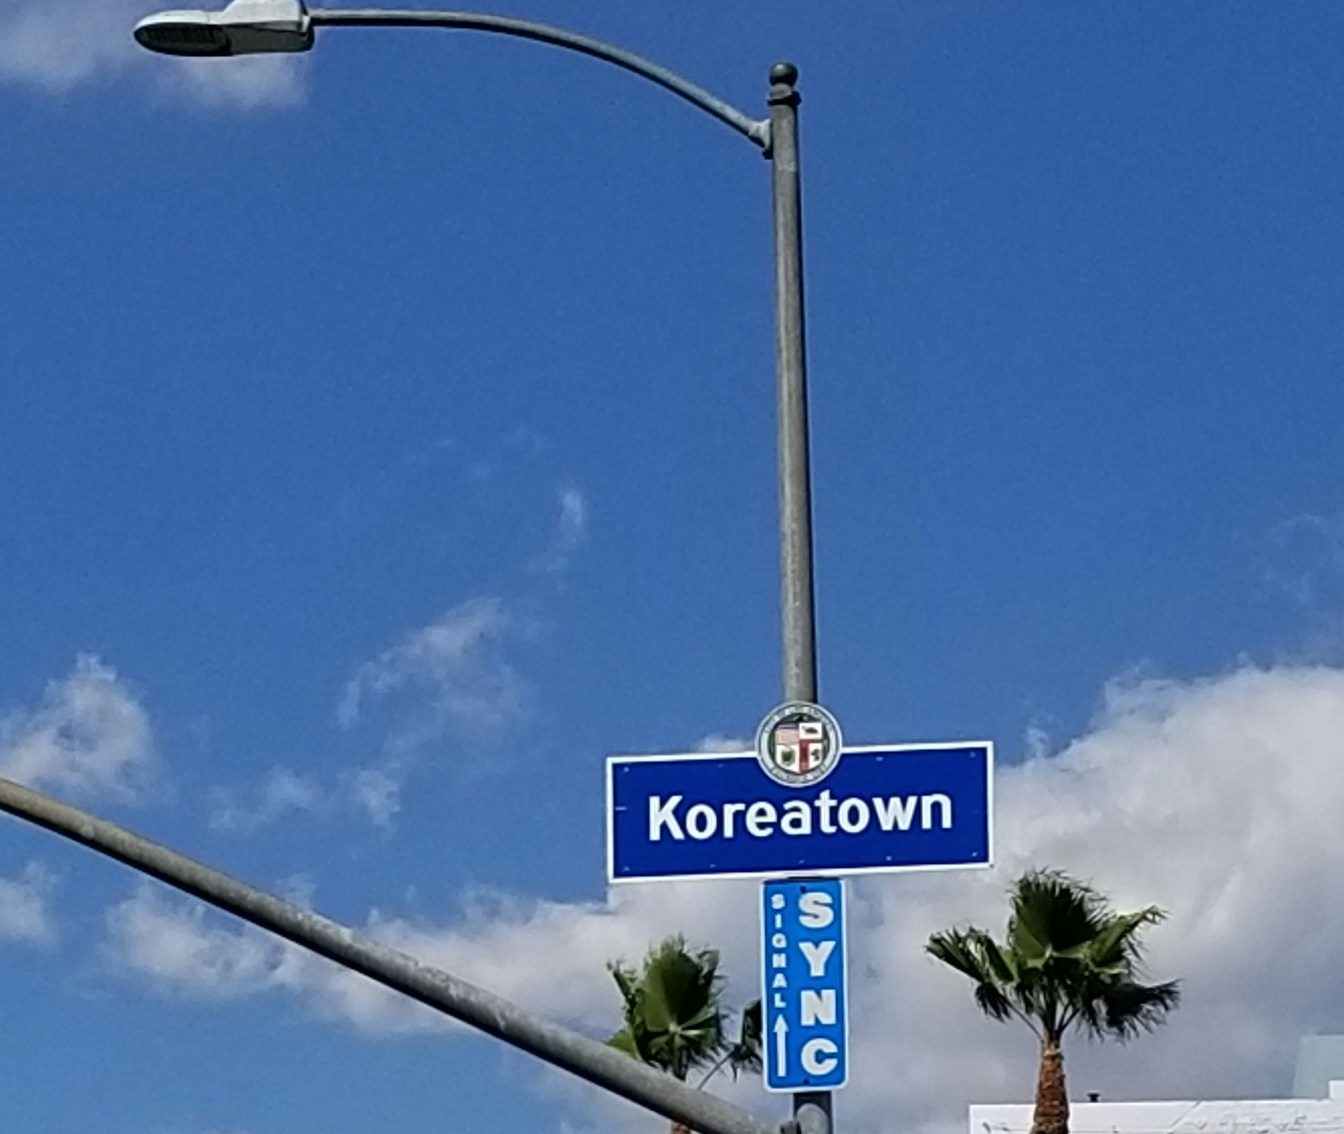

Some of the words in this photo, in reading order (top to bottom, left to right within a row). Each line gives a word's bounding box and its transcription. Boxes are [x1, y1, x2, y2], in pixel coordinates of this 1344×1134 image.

[647, 788, 953, 842] Koreatown
[770, 893, 789, 1009] SIGNAL
[797, 891, 840, 1077] SYNC
